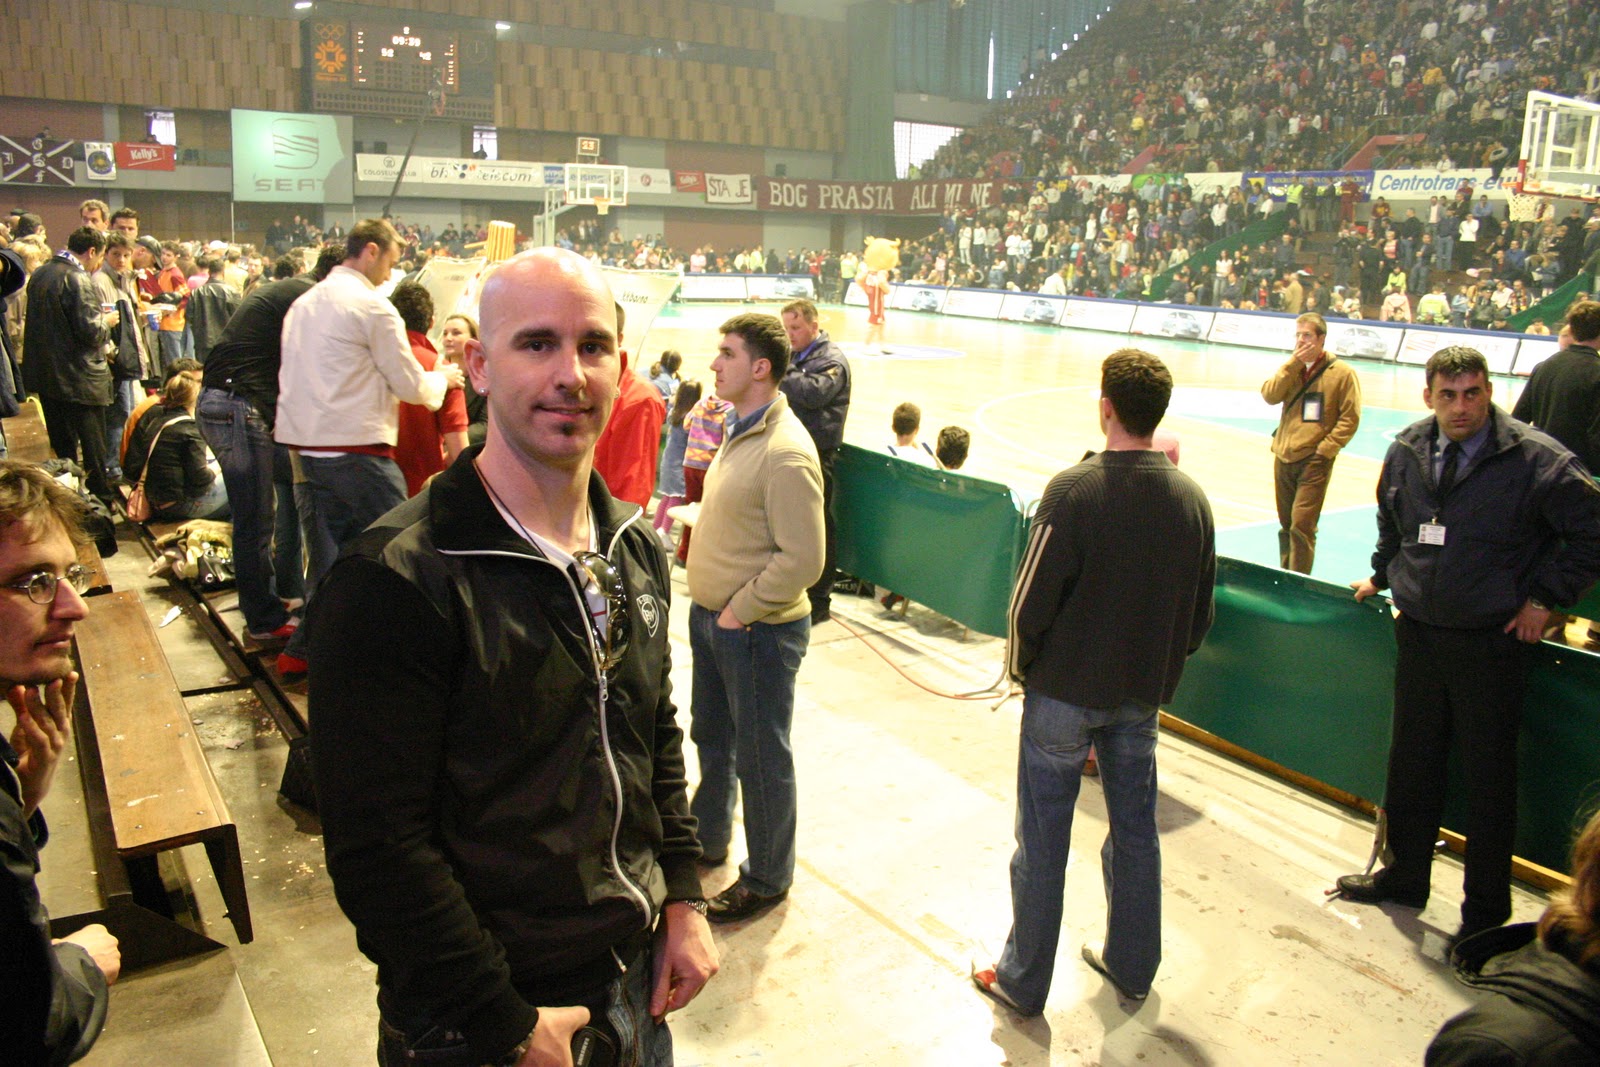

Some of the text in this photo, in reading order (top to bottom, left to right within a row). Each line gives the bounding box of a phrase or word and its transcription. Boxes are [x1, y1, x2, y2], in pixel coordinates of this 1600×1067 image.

[130, 148, 158, 161] Kelly's
[735, 179, 749, 198] JE
[768, 181, 808, 208] BOG
[910, 184, 938, 210] ALI
[970, 182, 993, 208] NE
